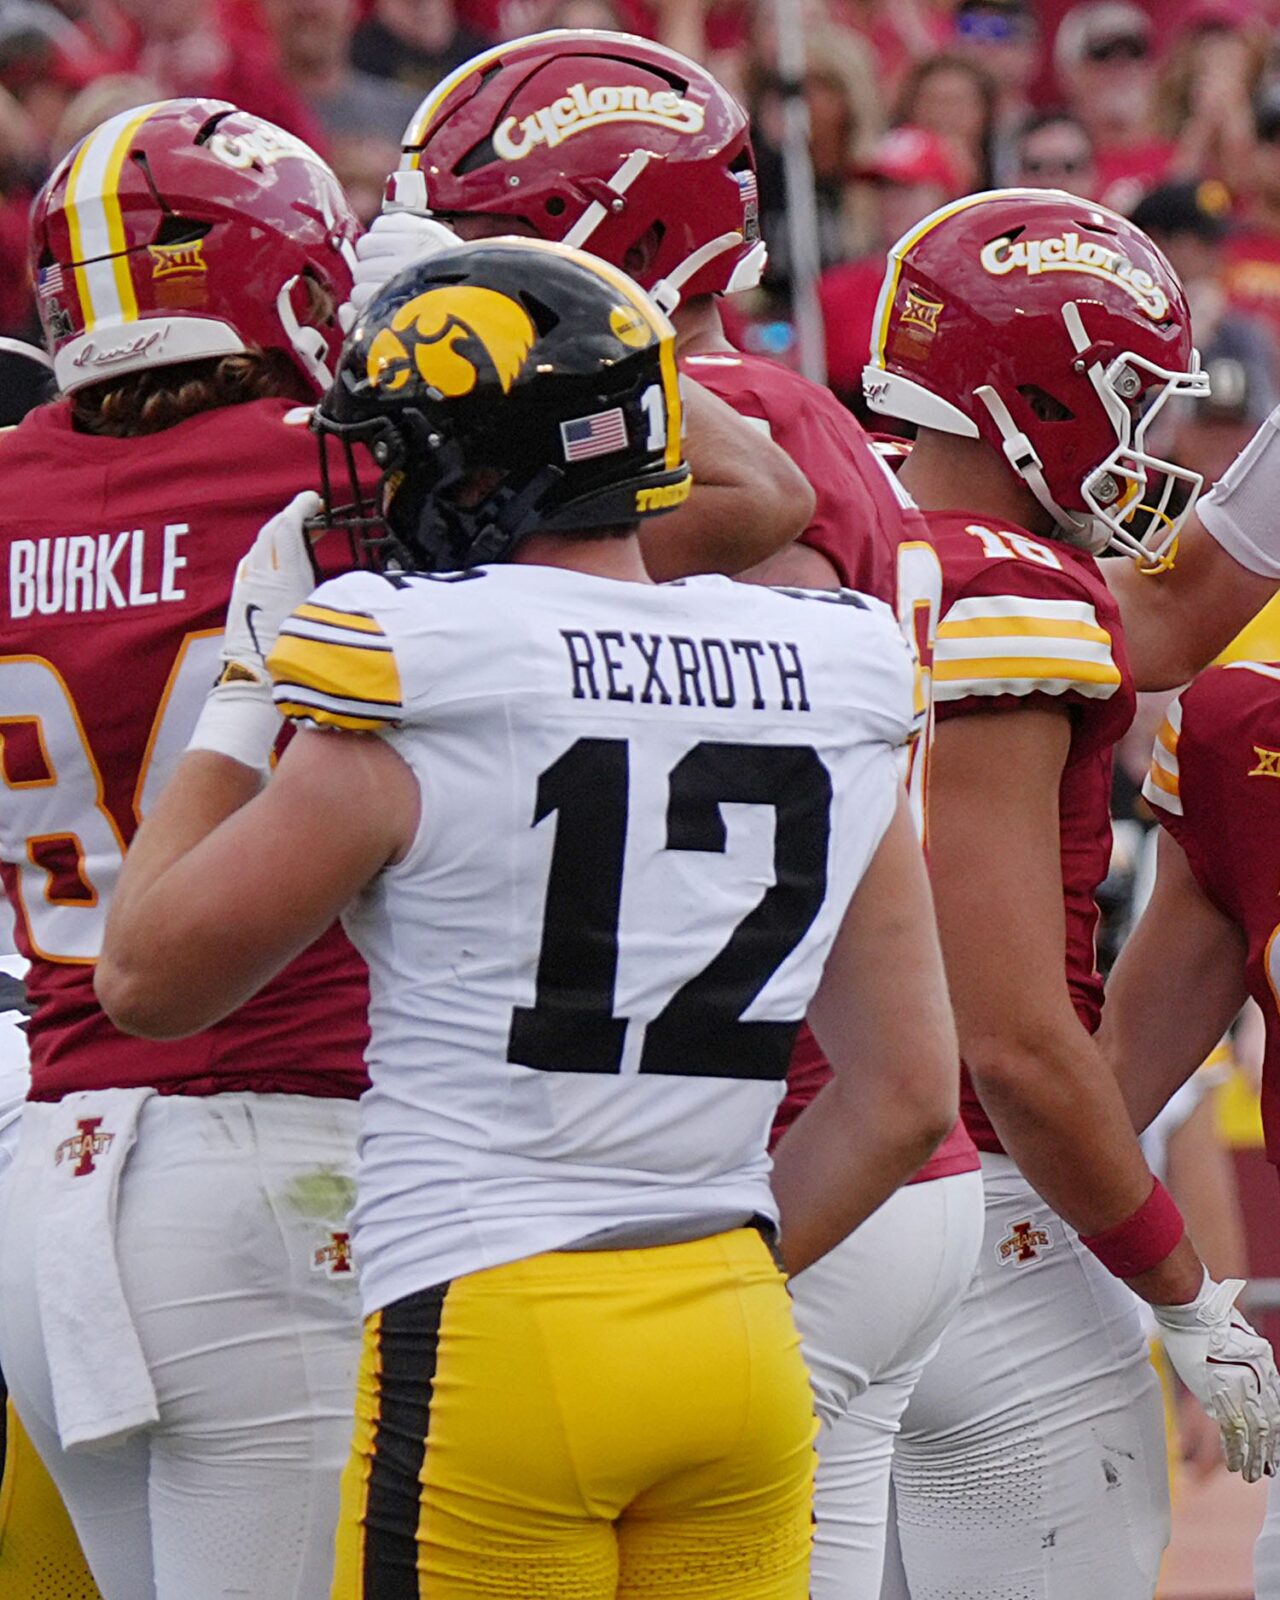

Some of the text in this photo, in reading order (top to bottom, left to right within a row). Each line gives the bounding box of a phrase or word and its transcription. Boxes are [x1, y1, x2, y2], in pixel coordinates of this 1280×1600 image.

[493, 83, 704, 160] Cyclones
[981, 233, 1169, 319] Cyclones
[10, 523, 189, 619] BURKLE
[559, 629, 810, 711] REXROTH
[506, 737, 833, 1081] 12
